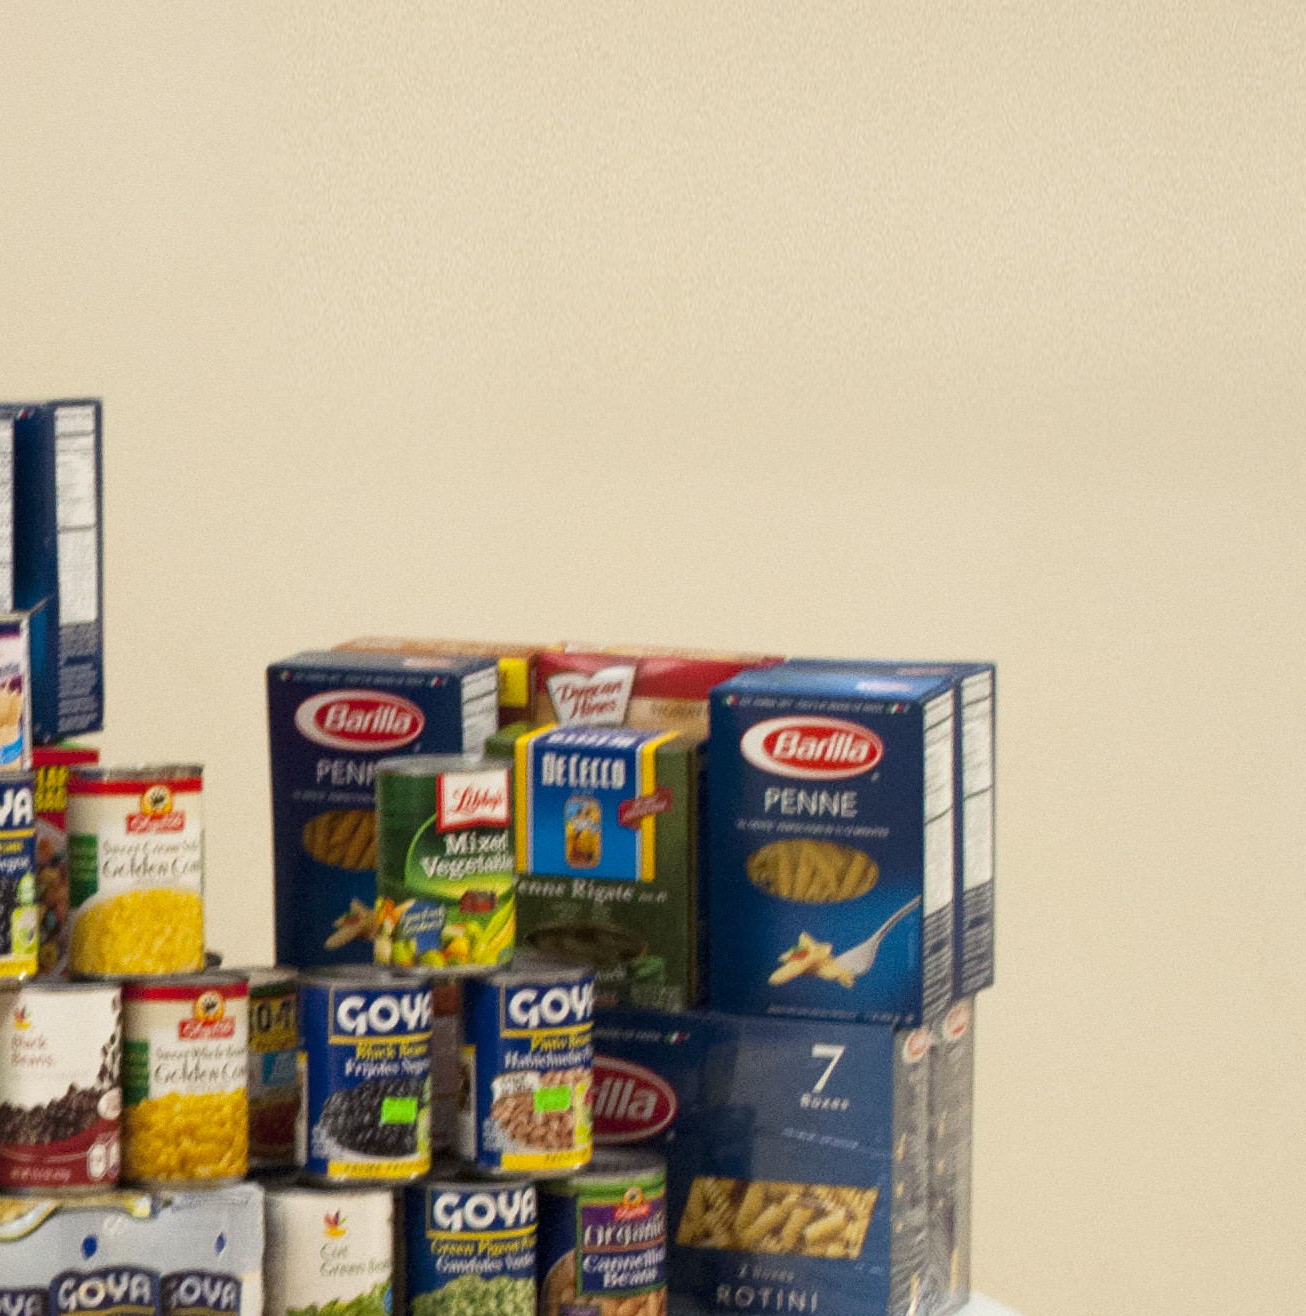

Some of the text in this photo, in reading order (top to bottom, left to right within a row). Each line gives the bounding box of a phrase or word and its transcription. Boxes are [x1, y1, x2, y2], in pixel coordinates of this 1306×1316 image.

[556, 679, 625, 703] Duncan
[324, 700, 414, 738] Barilla
[771, 728, 871, 764] Barilla
[316, 757, 376, 787] PEN
[763, 786, 859, 819] PENNE
[444, 829, 510, 855] Mixed
[810, 1042, 847, 1096] 7
[432, 1187, 537, 1233] GOYA
[319, 1241, 349, 1259] Cut
[319, 1260, 364, 1277] Green
[57, 1273, 152, 1311] GOYA
[716, 1284, 820, 1313] ROTINI
